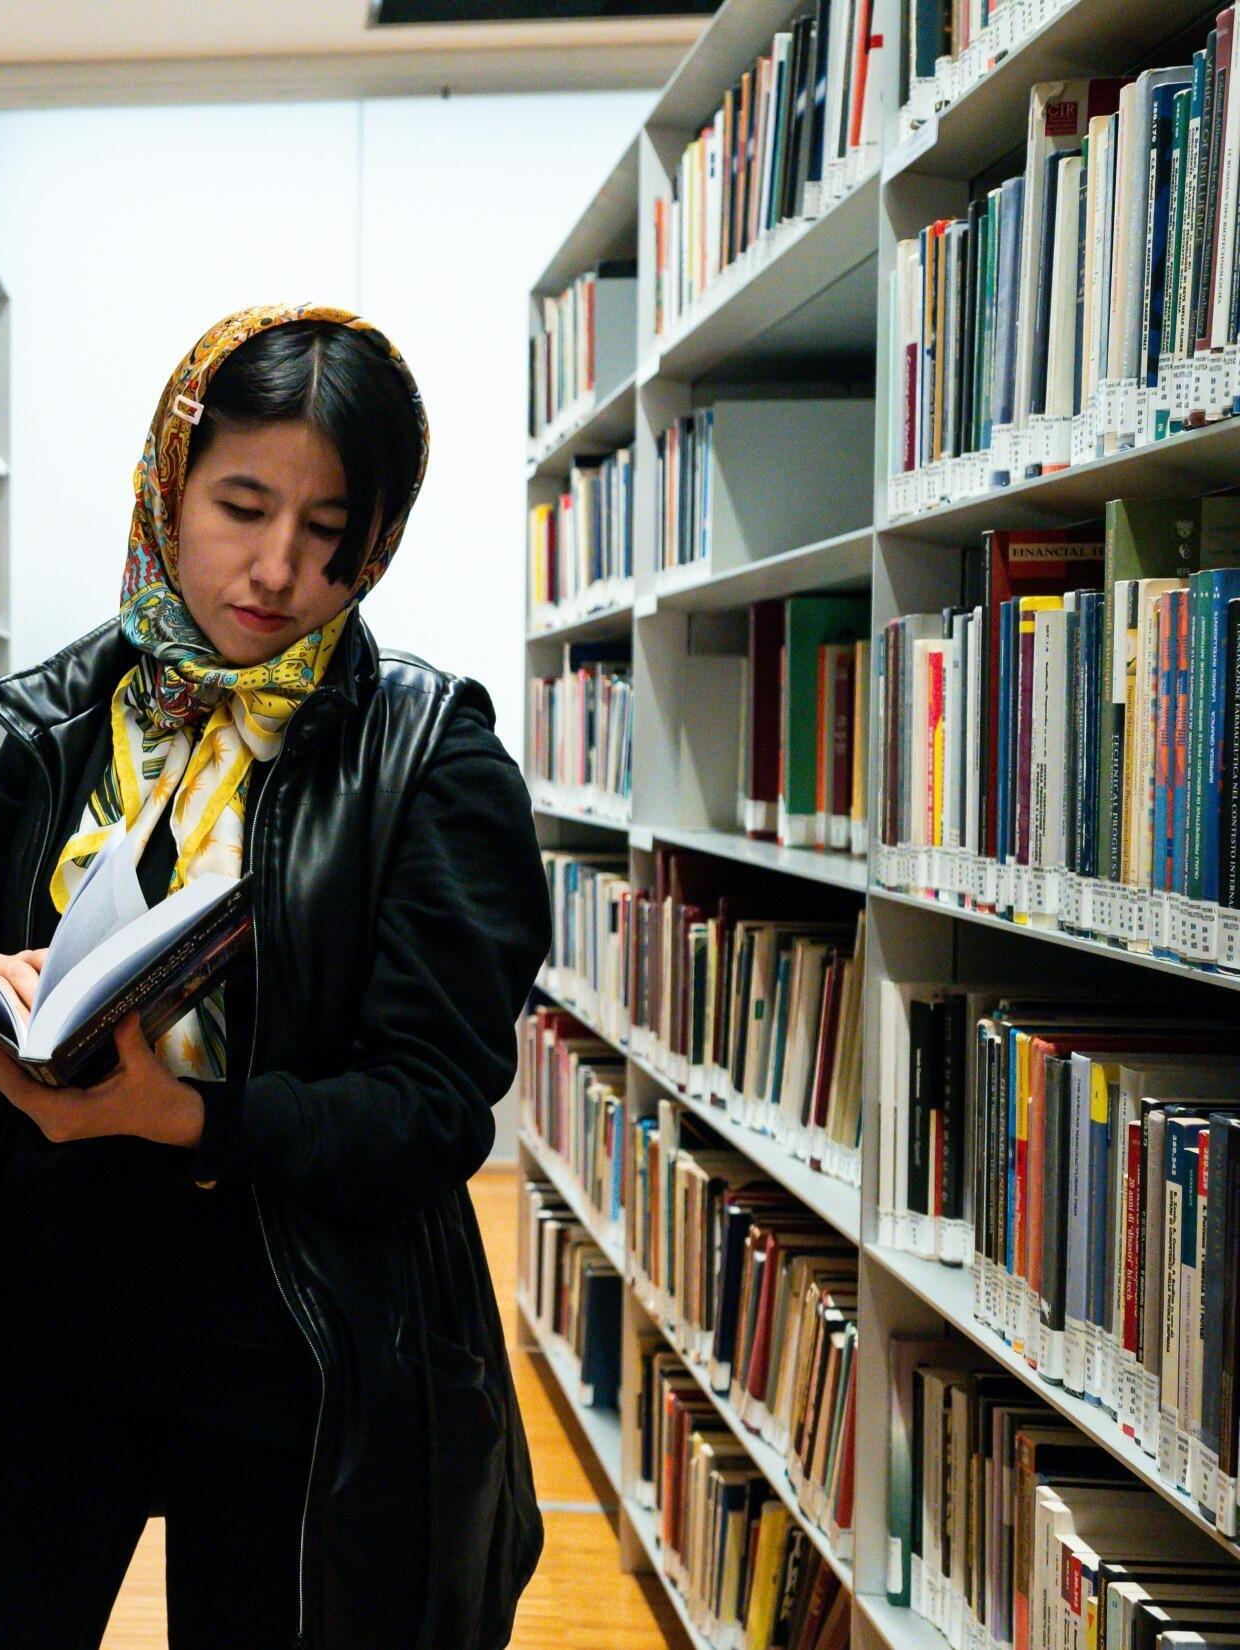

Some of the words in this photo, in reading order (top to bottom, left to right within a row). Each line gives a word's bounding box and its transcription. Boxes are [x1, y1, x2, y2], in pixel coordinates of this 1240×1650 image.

[1203, 56, 1213, 121] VEHICLE
[1203, 128, 1209, 150] OF
[1213, 117, 1222, 166] Alliances
[1228, 147, 1232, 158] LE
[1214, 170, 1219, 182] in
[1196, 157, 1207, 244] INFLUENCE
[1206, 207, 1214, 240] Motor
[1203, 243, 1211, 281] Vehicle
[1217, 222, 1228, 305] BIOTECHNOLOGIES
[1197, 284, 1208, 334] Industry
[1144, 324, 1148, 333] IN
[1012, 544, 1085, 558] FINANCIAL
[1232, 703, 1240, 780] FARMACEUTICA
[1126, 764, 1130, 772] in
[1128, 1177, 1134, 1188] 20
[1128, 1214, 1134, 1225] di
[1169, 1217, 1172, 1225] DI
[1117, 1274, 1121, 1284] IN
